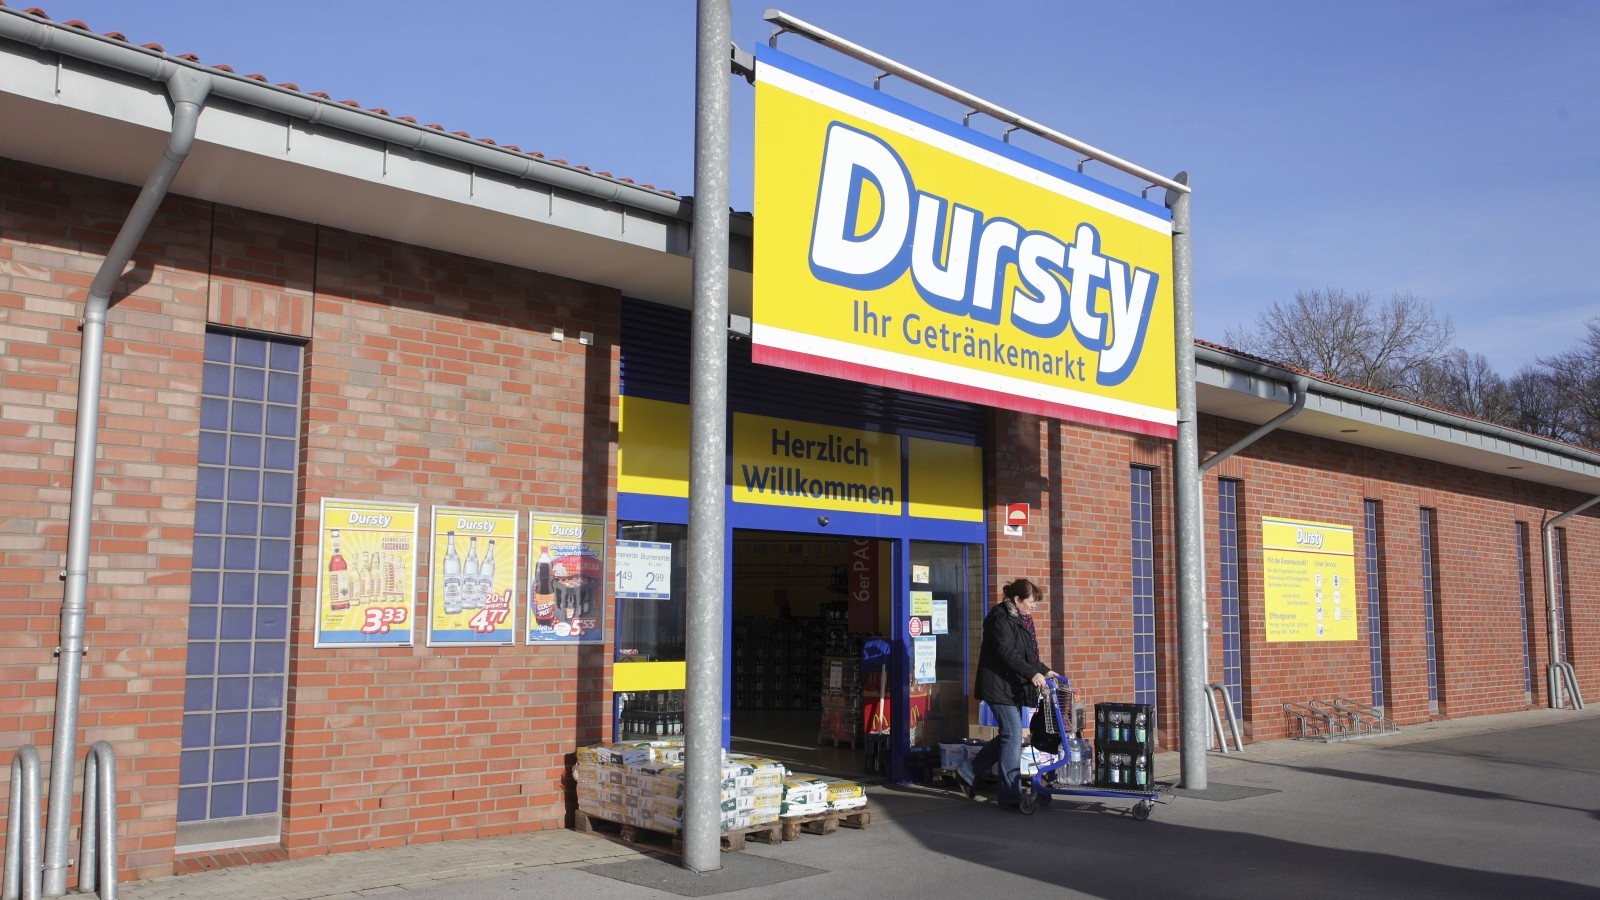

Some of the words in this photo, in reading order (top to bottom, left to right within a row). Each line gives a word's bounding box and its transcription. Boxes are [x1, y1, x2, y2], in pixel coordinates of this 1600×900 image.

[809, 120, 1159, 387] Dursty
[853, 300, 892, 338] Ihr
[902, 313, 1086, 382] Getränkemarkt
[772, 428, 869, 467] Herzlich
[741, 463, 894, 506] Willkommen
[348, 511, 392, 528] Dursty
[457, 518, 496, 534] Dursty
[550, 523, 585, 539] Dursty
[1296, 527, 1324, 549] Dursty
[362, 608, 406, 632] 3.33
[470, 609, 509, 631] 4.77
[570, 619, 596, 636] 5.55
